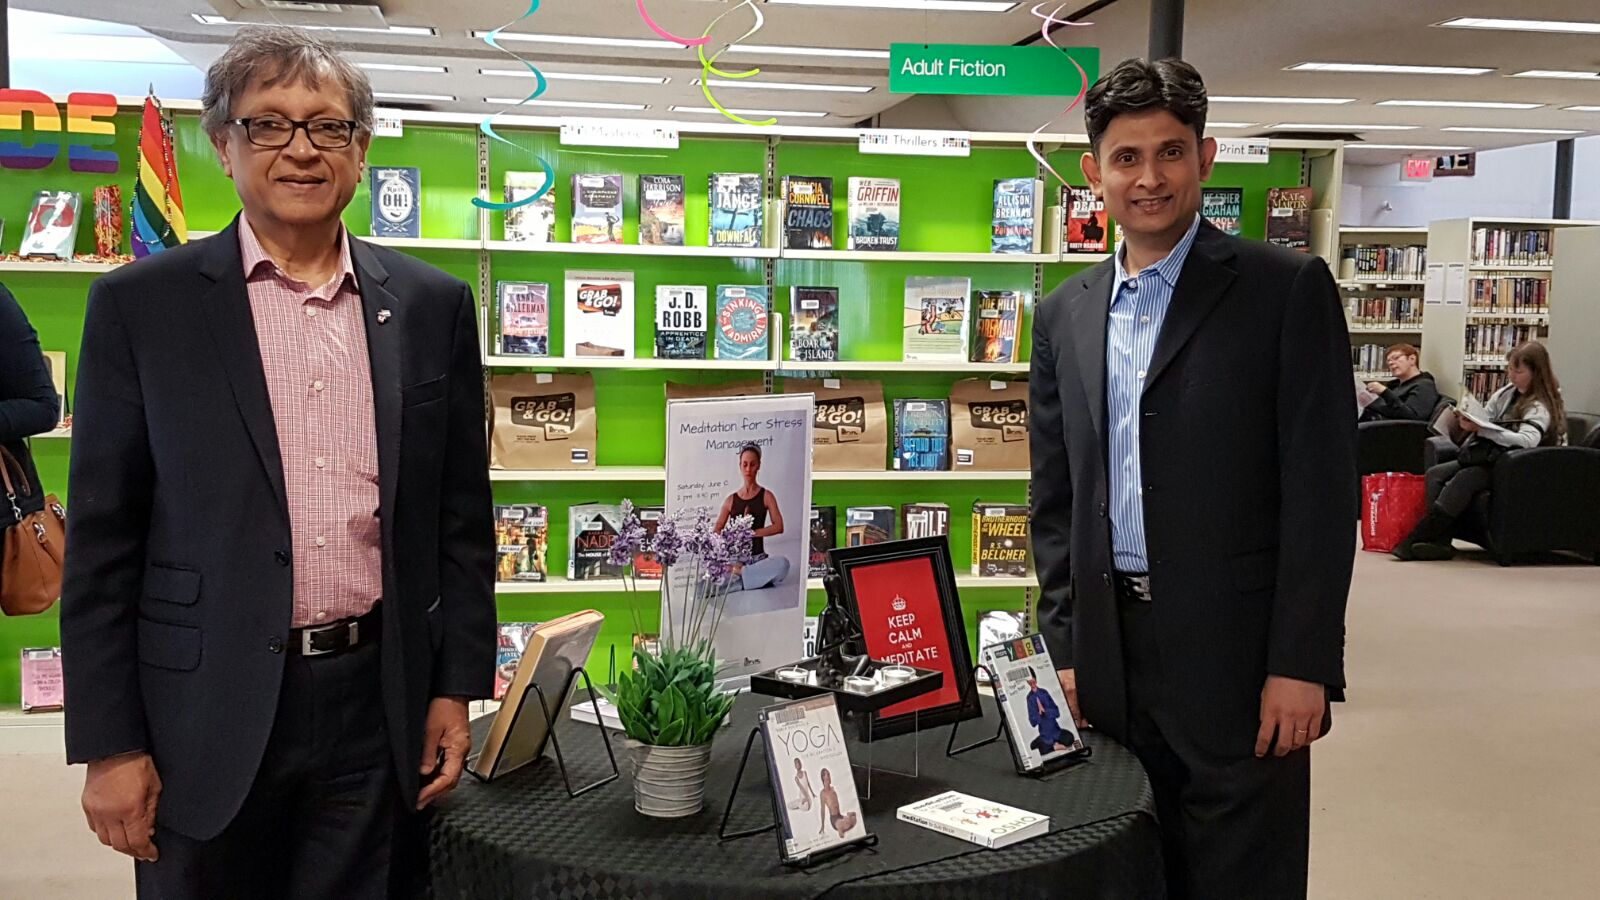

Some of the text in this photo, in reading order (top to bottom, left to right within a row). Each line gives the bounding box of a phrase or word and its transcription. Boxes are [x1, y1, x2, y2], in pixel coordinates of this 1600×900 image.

[901, 57, 1006, 77] Adult Fiction
[893, 134, 938, 148] Thrillers
[1219, 143, 1246, 155] Print
[1407, 159, 1431, 177] EXIT
[643, 183, 681, 192] HARRISON
[857, 186, 899, 202] GRIFFIN
[383, 193, 408, 207] OH!
[716, 192, 759, 209] JANCE
[789, 192, 831, 206] CORNWELL
[997, 193, 1031, 208] ALLISON
[1281, 191, 1300, 201] KAT
[1073, 200, 1105, 211] DEAD
[1203, 204, 1240, 216] GRAHAM
[1272, 199, 1307, 209] MARTIN
[788, 209, 833, 228] CHAOS
[855, 236, 898, 245] BROKEN TRUST
[579, 289, 608, 300] GRAB
[593, 295, 618, 308] GO!
[722, 298, 763, 318] SINKING
[997, 298, 1016, 310] HILL
[662, 310, 702, 328] ROBB
[727, 324, 766, 343] ADMIRAL
[798, 338, 820, 349] BOAR
[805, 349, 835, 360] ISLAND
[514, 401, 557, 412] GRAB
[972, 405, 1010, 415] GRAB
[536, 407, 573, 422] GO!
[828, 409, 863, 425] GO!
[993, 410, 1026, 425] GO!
[679, 417, 803, 435] Meditation for Stress
[677, 482, 705, 491] Saturday
[981, 515, 1027, 523] BROTHERHOOD
[988, 522, 1027, 537] WHEEL
[981, 549, 1026, 560] BELCHER
[887, 613, 916, 628] KEEP
[888, 627, 923, 644] CALM
[880, 646, 938, 664] MEDITATE
[777, 723, 840, 756] YOGA
[902, 813, 928, 826] meditation
[990, 815, 1038, 835] OSHO
